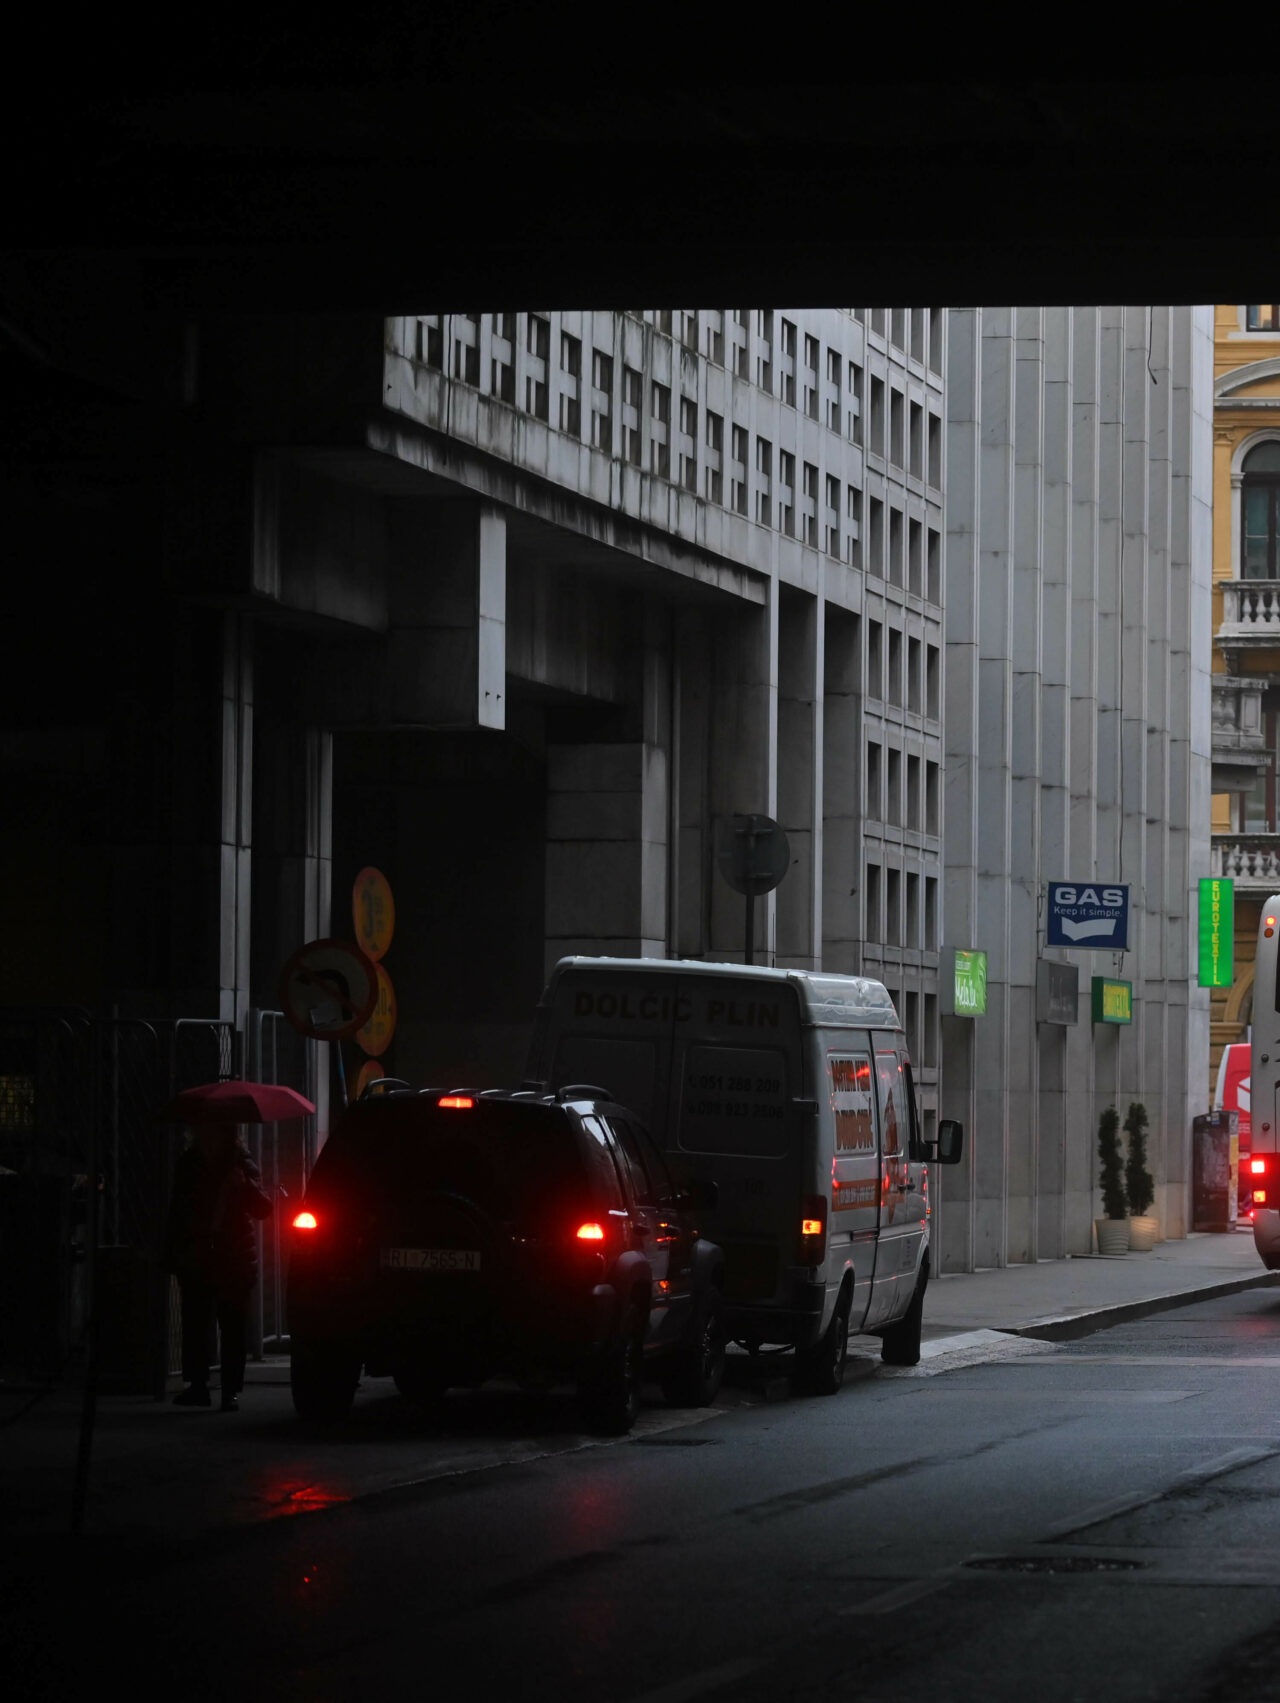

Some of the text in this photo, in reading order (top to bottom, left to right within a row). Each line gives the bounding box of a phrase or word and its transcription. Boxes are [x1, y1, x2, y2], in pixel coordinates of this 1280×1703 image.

[1054, 887, 1124, 907] GAS
[1053, 906, 1078, 917] Keep
[1079, 907, 1088, 916] it
[1211, 881, 1222, 985] EUROTEXTIL
[574, 990, 780, 1028] DOLČIĆ PLIN
[391, 1250, 407, 1266] RI
